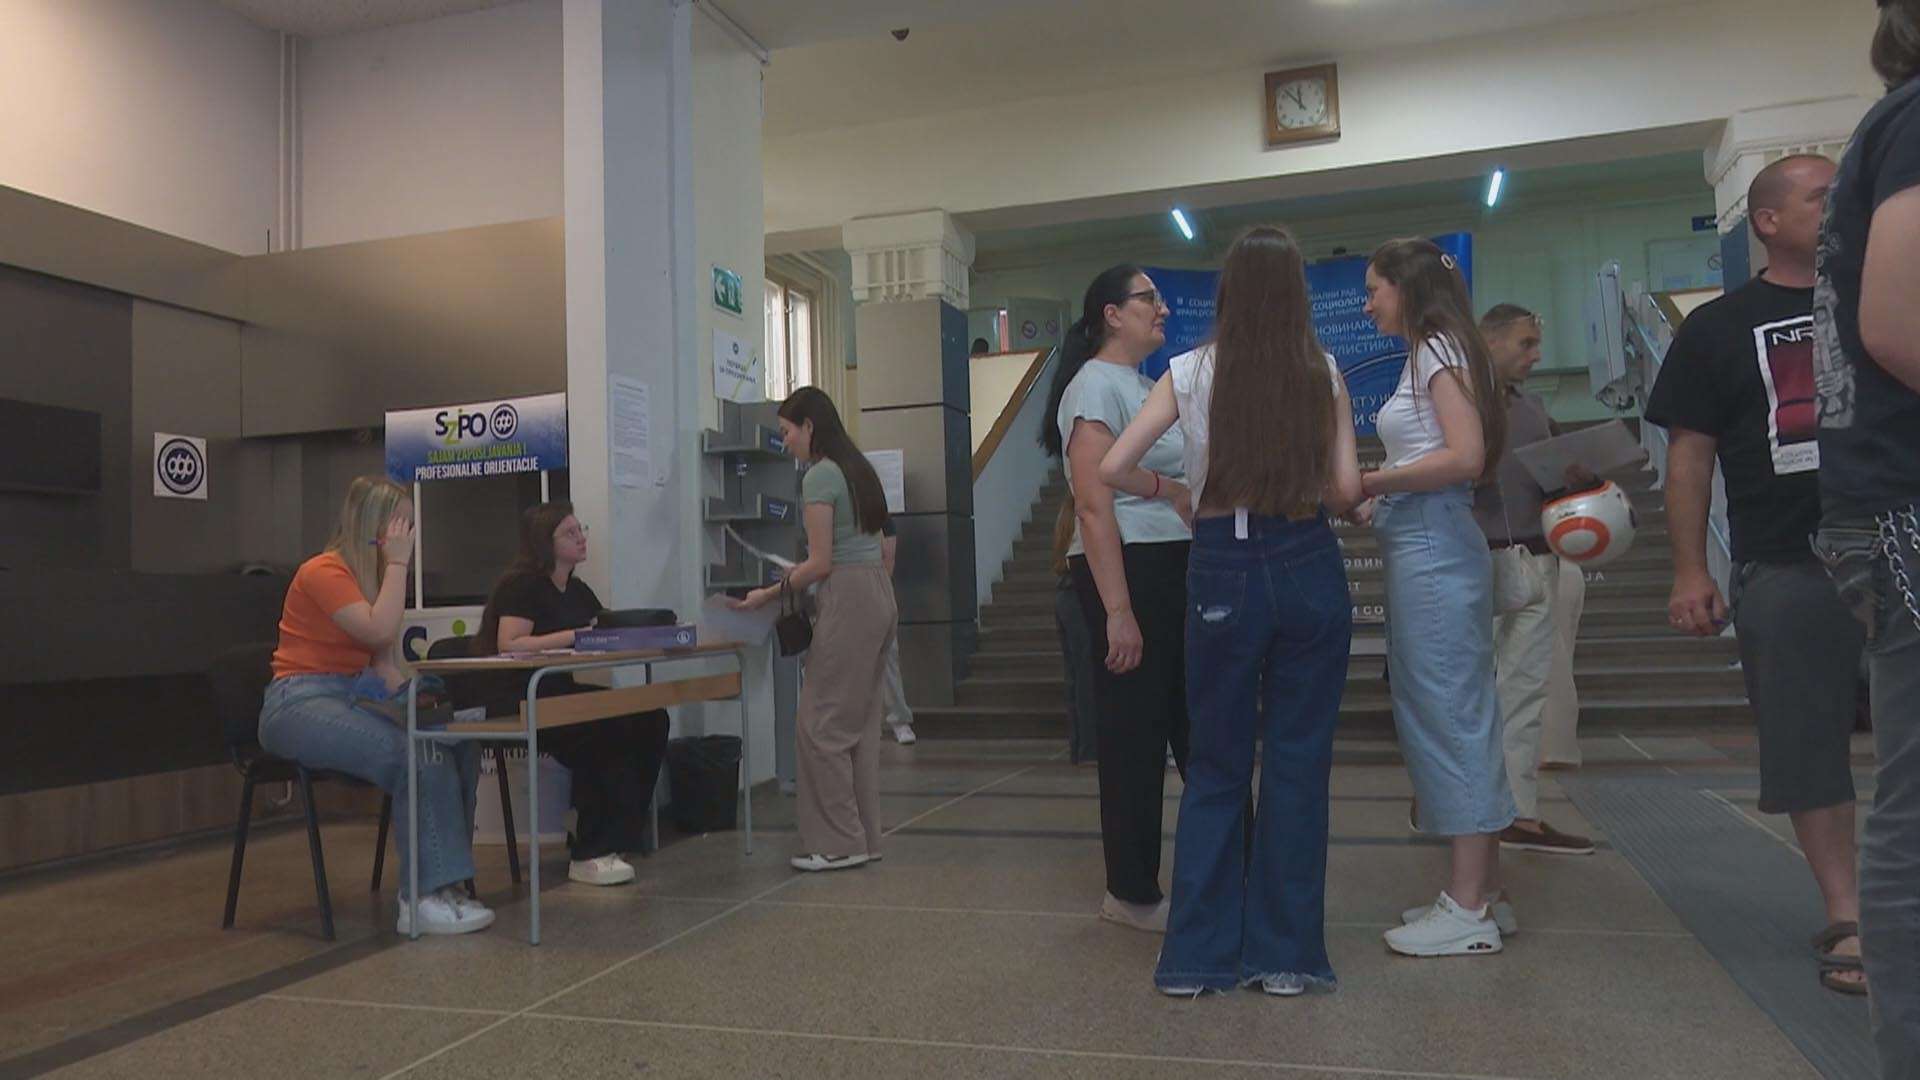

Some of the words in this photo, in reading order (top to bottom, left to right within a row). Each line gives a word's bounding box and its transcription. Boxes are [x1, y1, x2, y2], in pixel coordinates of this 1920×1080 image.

[1312, 295, 1368, 312] СОЦИОЛОГИ
[1315, 319, 1376, 337] НОВИНАРС
[1329, 337, 1395, 356] ГЛИСТИКА
[415, 460, 483, 481] PROFESIONALNE
[484, 456, 539, 476] ORIJENTACIJE
[1343, 557, 1384, 569] ОВИН
[1363, 604, 1385, 616] СО
